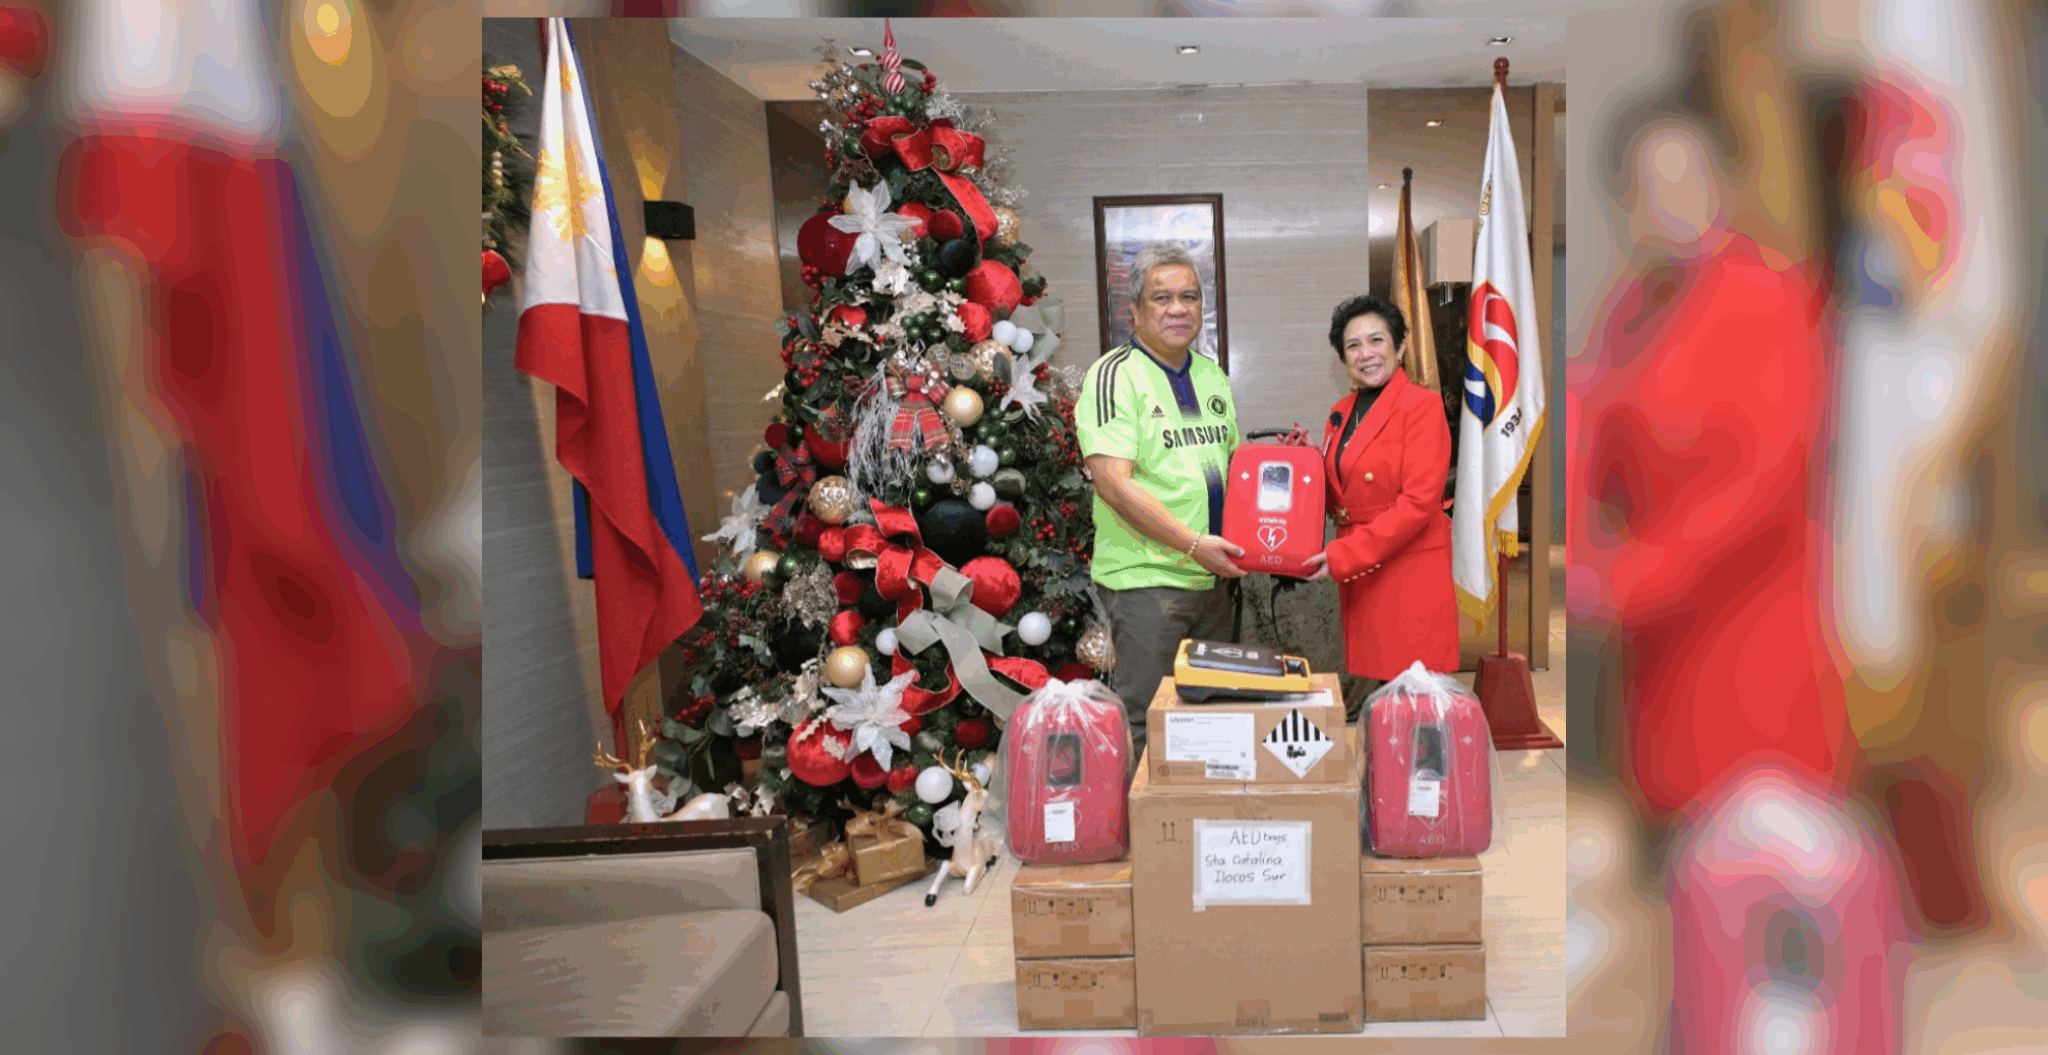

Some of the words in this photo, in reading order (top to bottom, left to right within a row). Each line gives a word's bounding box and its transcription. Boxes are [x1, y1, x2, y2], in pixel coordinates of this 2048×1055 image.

[1260, 555, 1283, 565] AED
[1230, 829, 1261, 846] AED
[1264, 831, 1287, 845] bags
[1205, 853, 1226, 867] Sta
[1214, 869, 1254, 883] Ilocos
[1263, 868, 1286, 881] Sur
